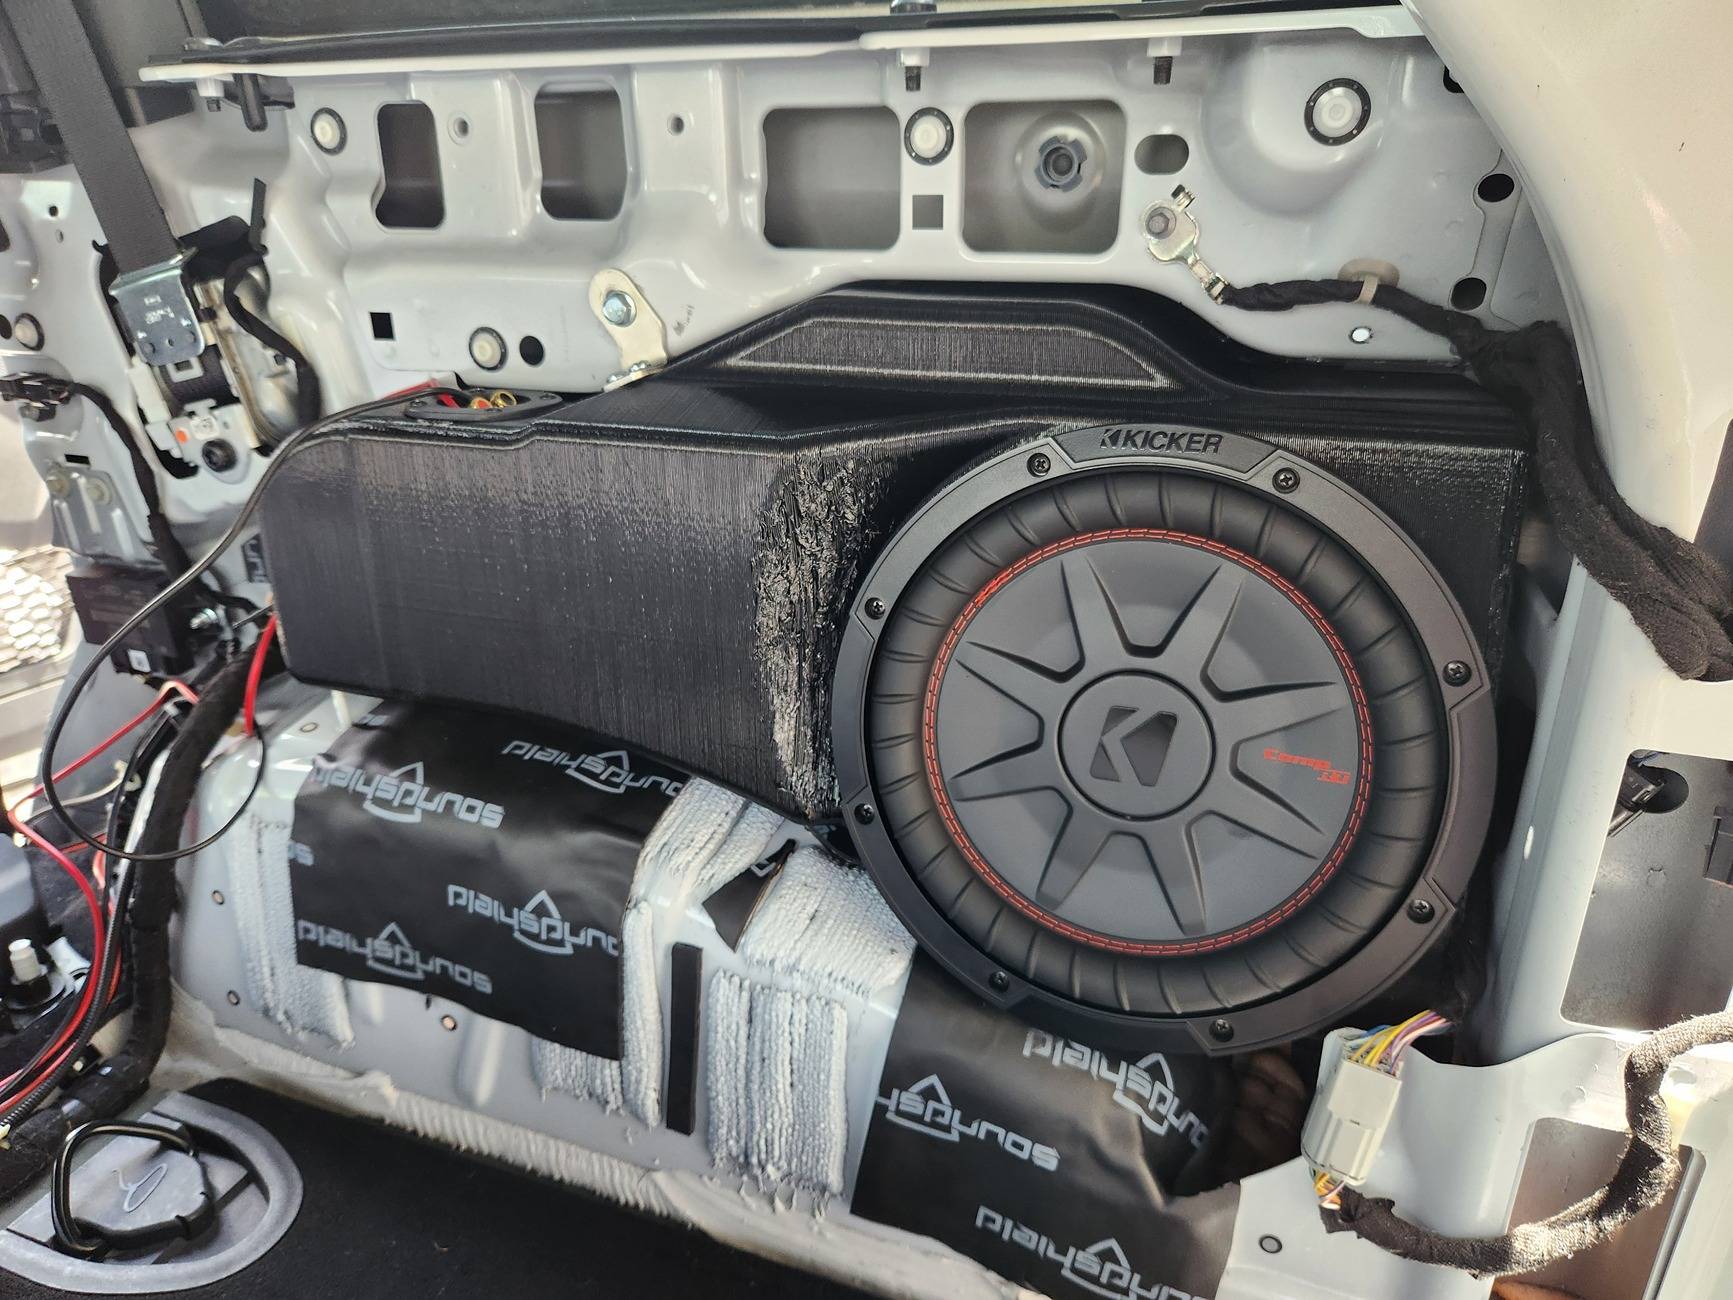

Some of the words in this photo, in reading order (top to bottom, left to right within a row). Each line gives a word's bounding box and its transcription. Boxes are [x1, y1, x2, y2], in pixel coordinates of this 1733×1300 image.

[1120, 428, 1224, 454] KICKER
[500, 739, 684, 798] oundshield
[447, 884, 619, 957] oundshield
[296, 919, 493, 995] soundshield
